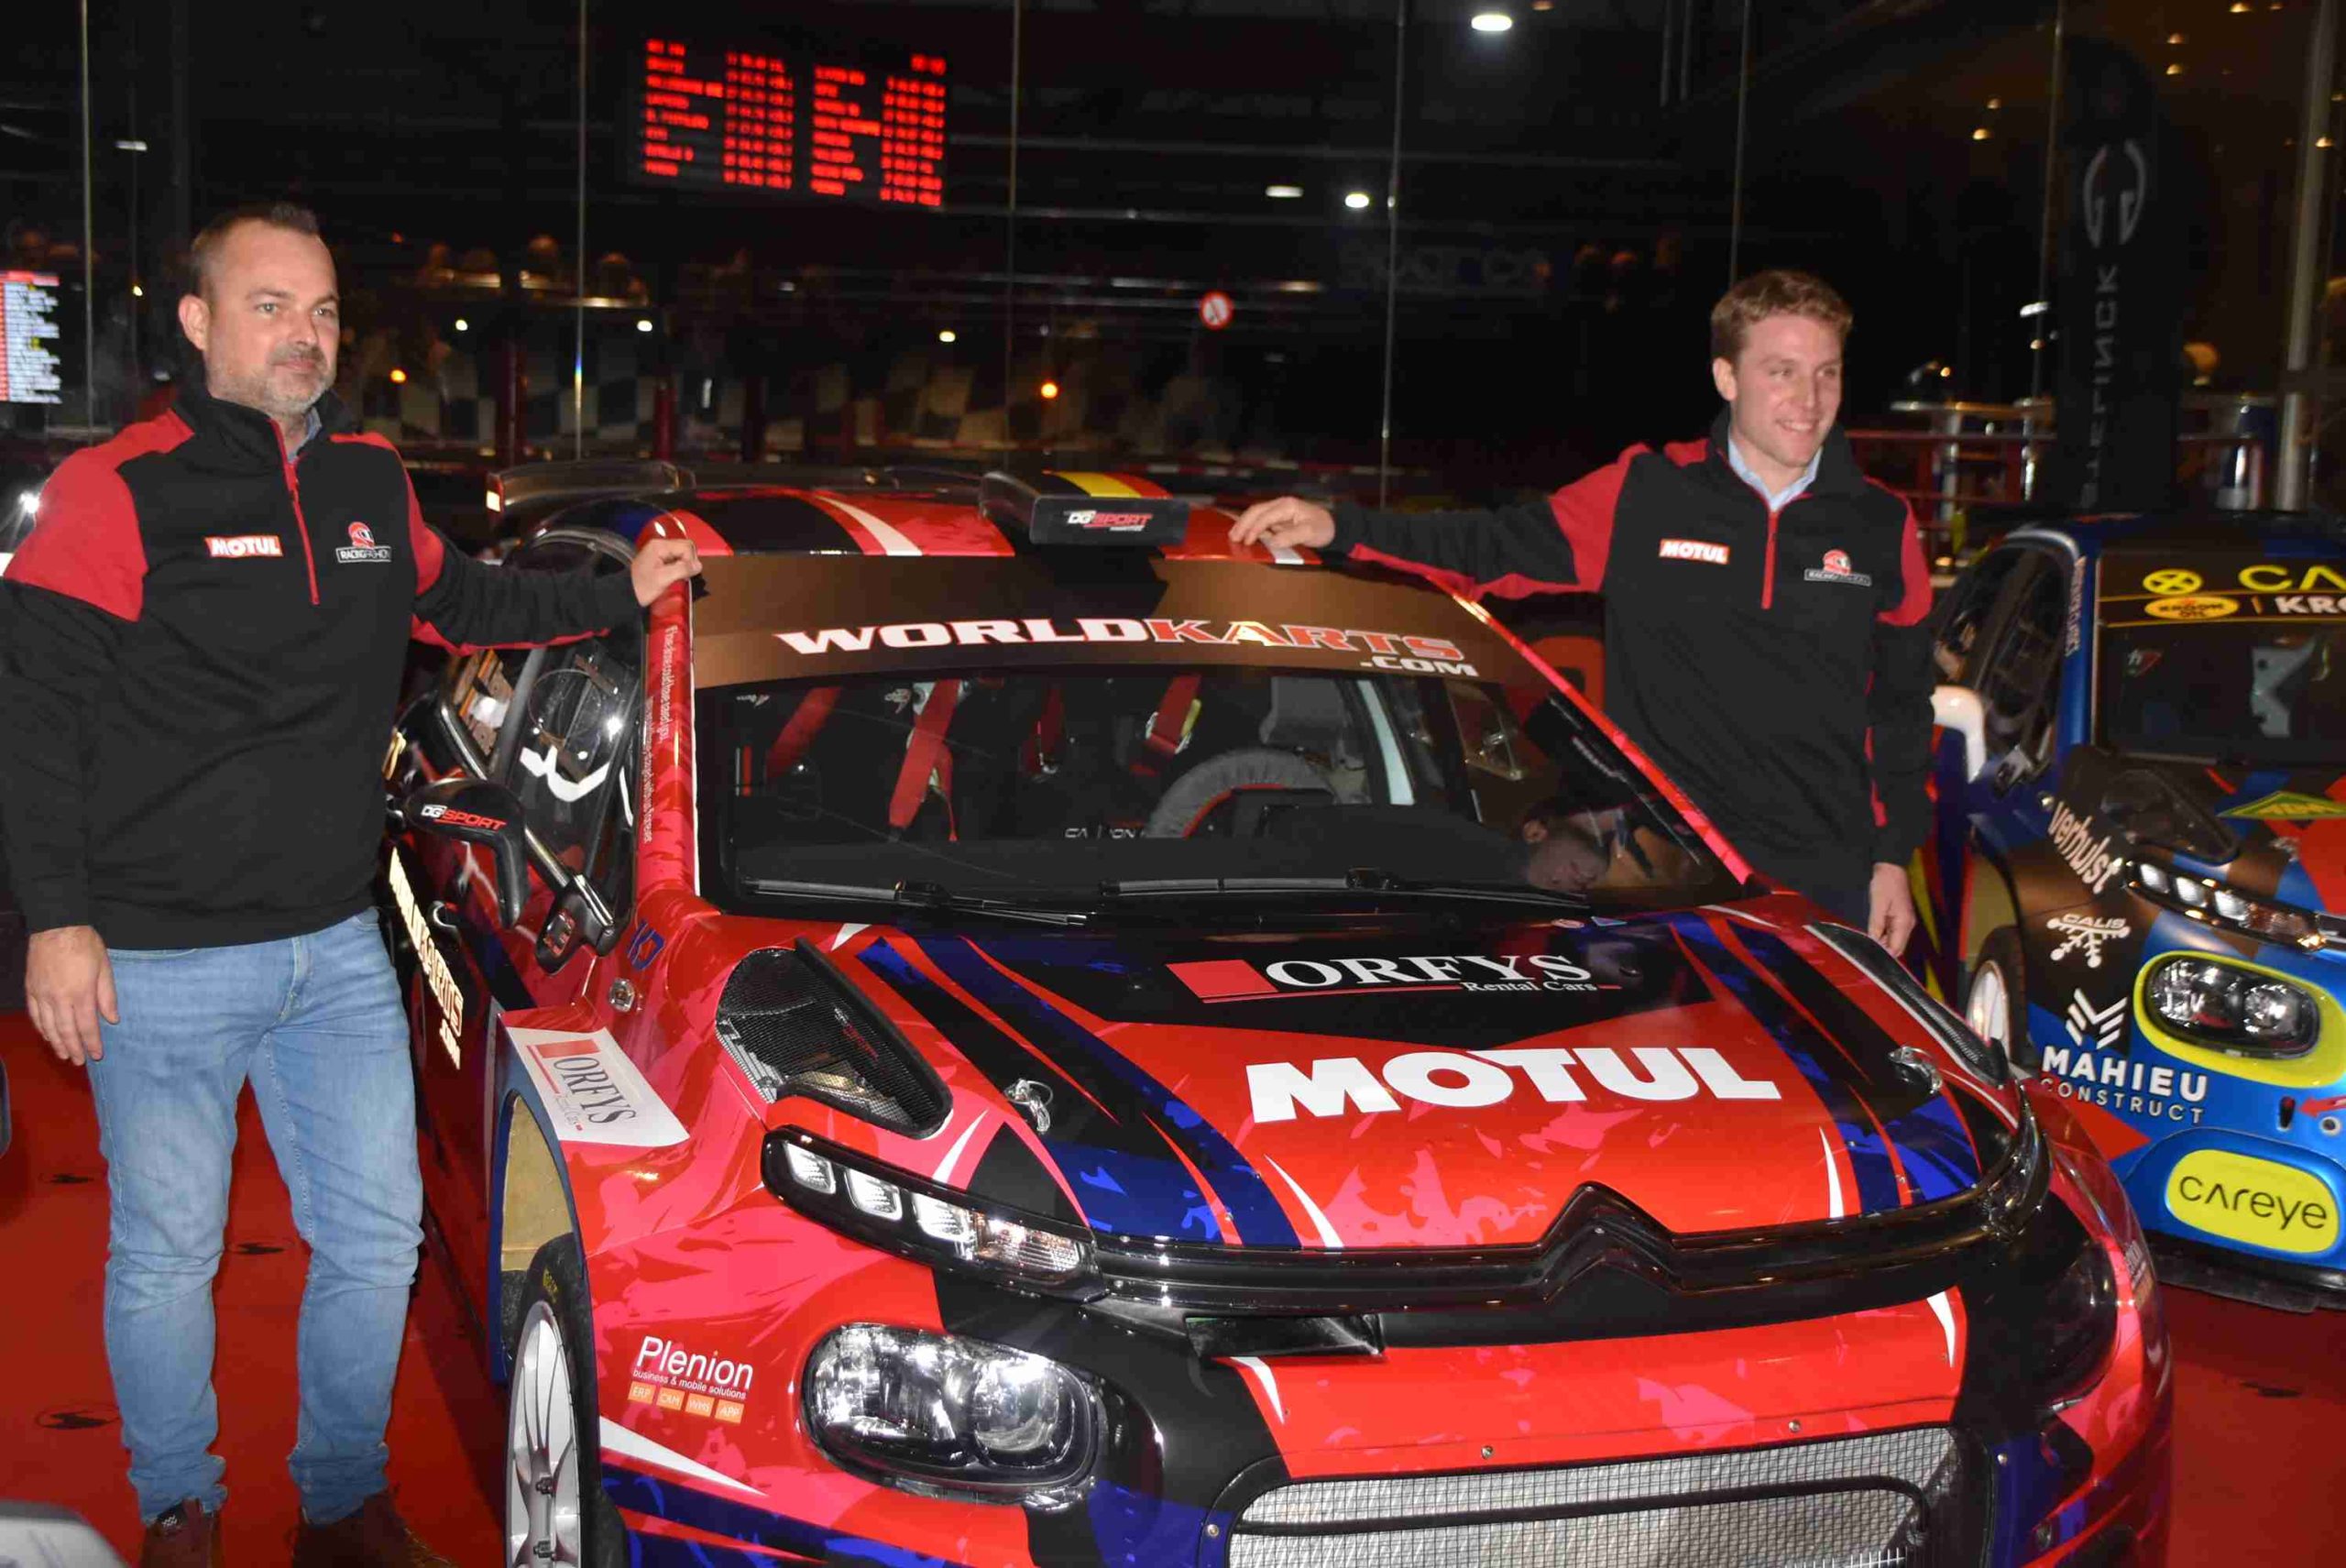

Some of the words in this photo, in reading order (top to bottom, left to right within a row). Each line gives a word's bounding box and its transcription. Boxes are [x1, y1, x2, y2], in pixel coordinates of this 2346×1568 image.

[210, 537, 282, 556] MOTUL
[1661, 540, 1727, 564] MOTUL
[773, 618, 1466, 662] WORLDKARTS
[1360, 655, 1480, 677] .COM
[421, 805, 507, 830] DGSPORT
[2048, 801, 2123, 894] verhulst
[2063, 914, 2127, 928] CALIS
[1266, 954, 1592, 987] ORFYS
[1460, 981, 1542, 992] Rental
[1542, 981, 1598, 992] Cars
[1244, 1047, 1782, 1124] MOTUL
[2042, 1046, 2208, 1102] MAHIEU
[553, 1057, 637, 1124] ORFYS
[636, 1335, 754, 1390] Plenion
[632, 1368, 669, 1385] business
[670, 1376, 677, 1386] &
[679, 1379, 707, 1392] mobile
[708, 1386, 747, 1399] solutions
[632, 1386, 652, 1398] ERP
